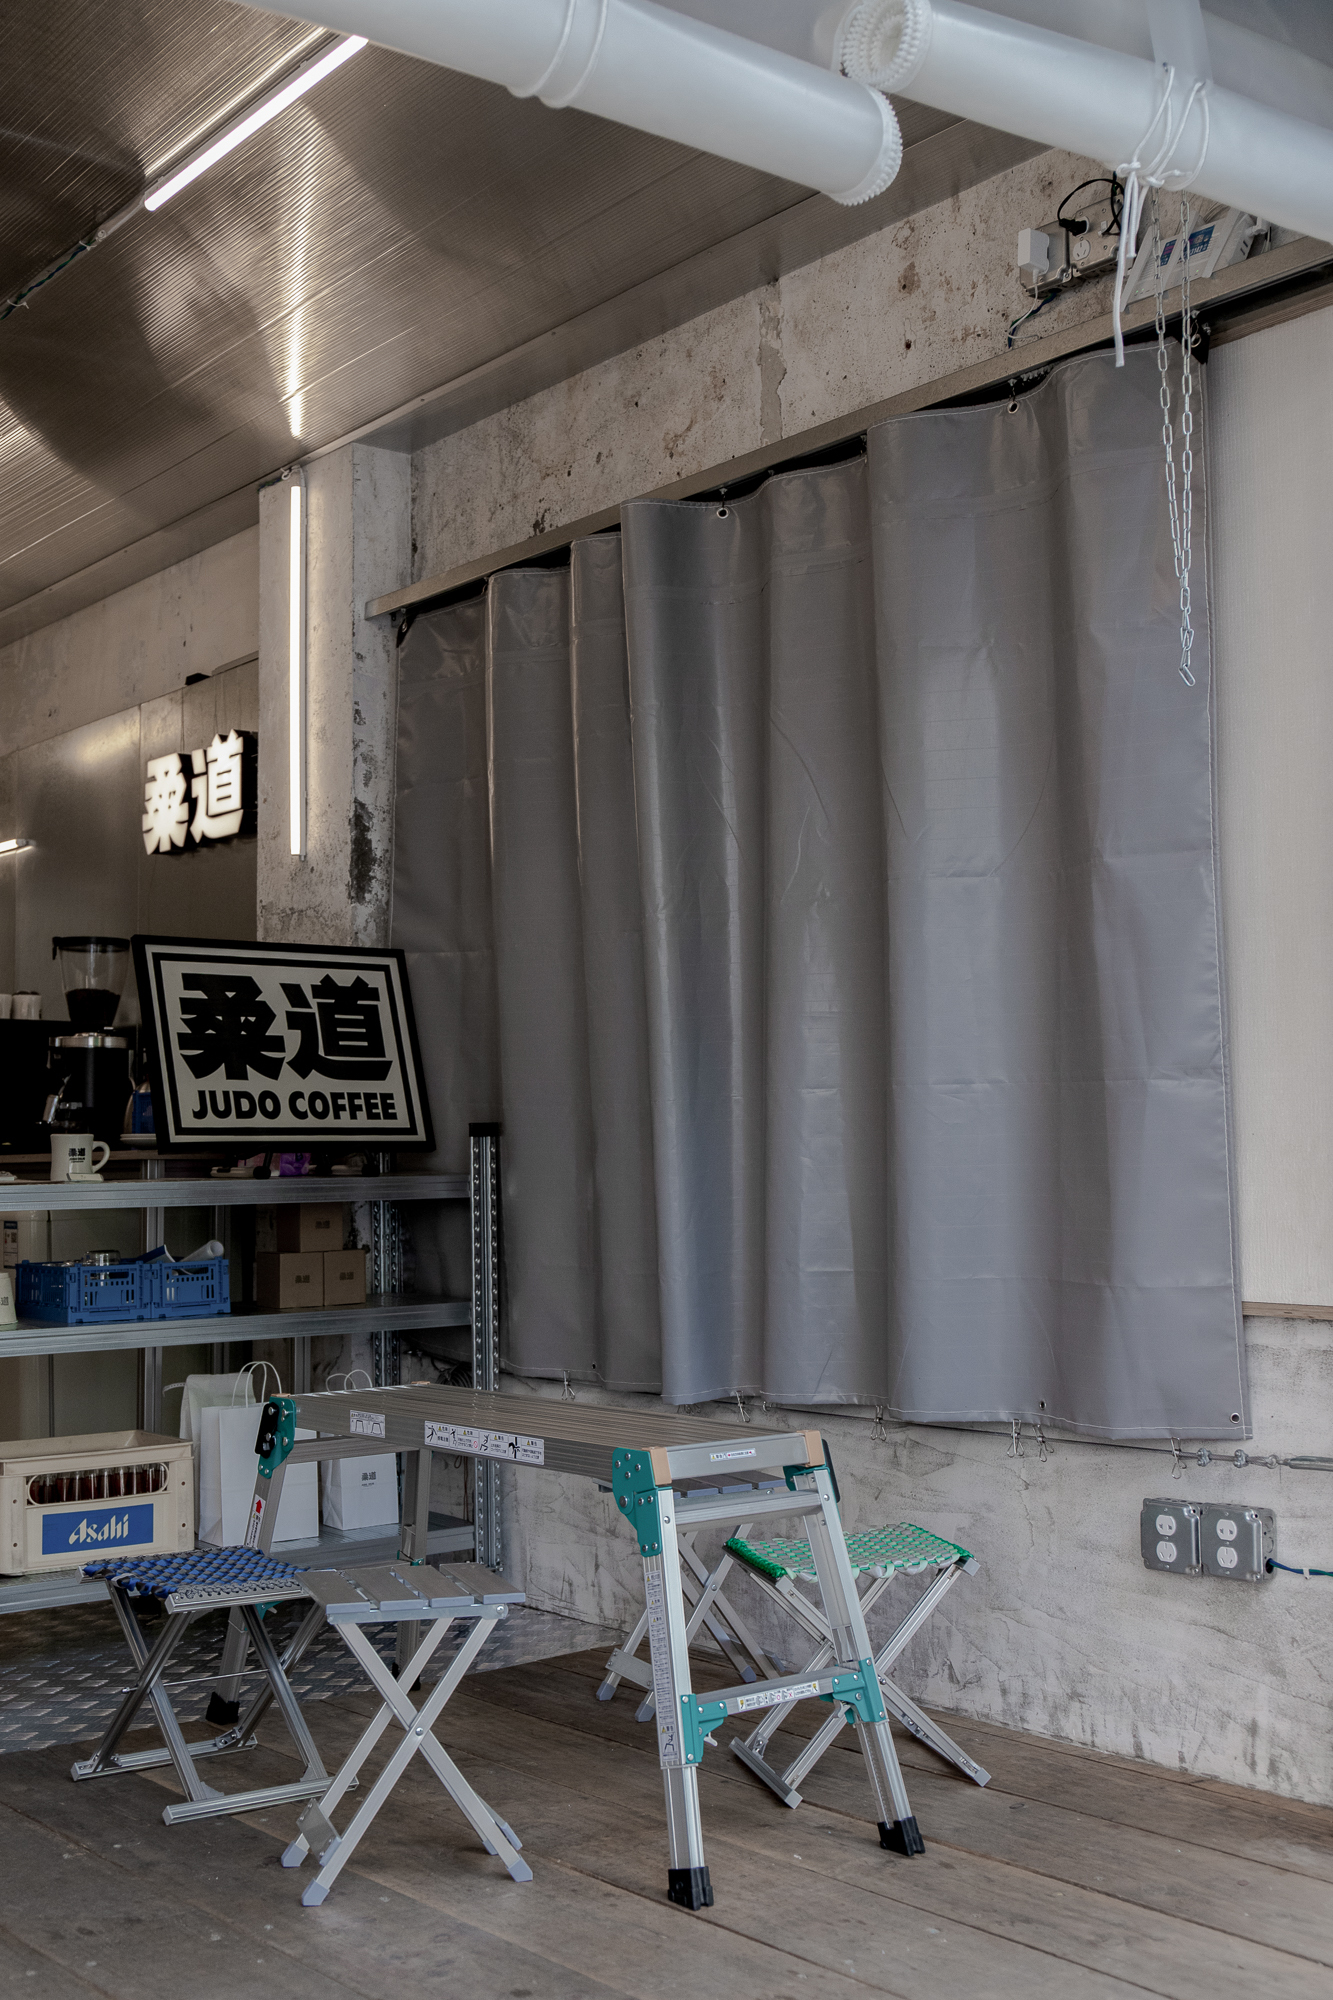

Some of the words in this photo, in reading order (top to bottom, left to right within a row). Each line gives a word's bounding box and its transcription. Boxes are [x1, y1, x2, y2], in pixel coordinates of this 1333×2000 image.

[142, 729, 244, 855] 柔道
[177, 973, 393, 1081] 柔道
[191, 1090, 281, 1120] JUDO
[288, 1090, 398, 1121] COFFEE
[68, 1513, 129, 1545] Asahi
